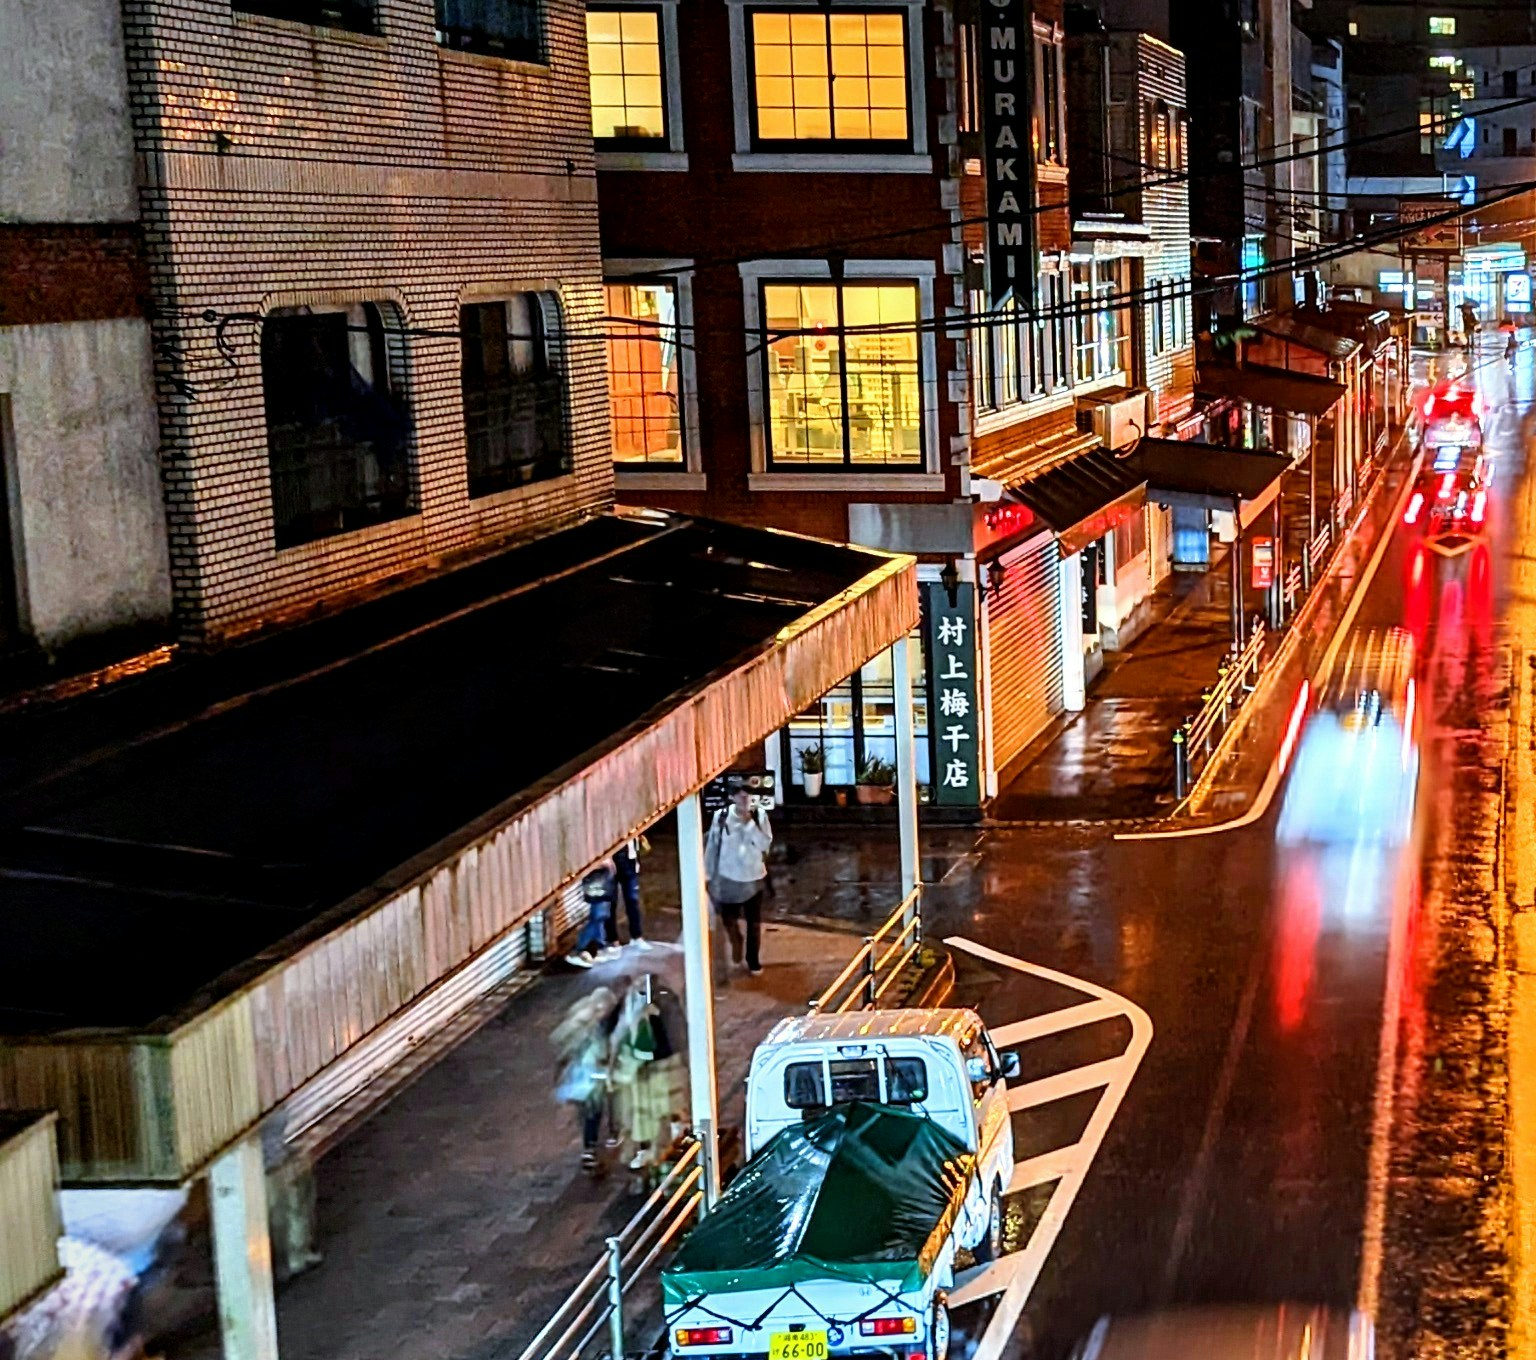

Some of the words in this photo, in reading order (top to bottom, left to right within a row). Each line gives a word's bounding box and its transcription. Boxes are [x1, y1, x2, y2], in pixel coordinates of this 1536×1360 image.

[937, 615, 971, 789] 村上梅干店
[782, 1342, 824, 1359] 66-00
